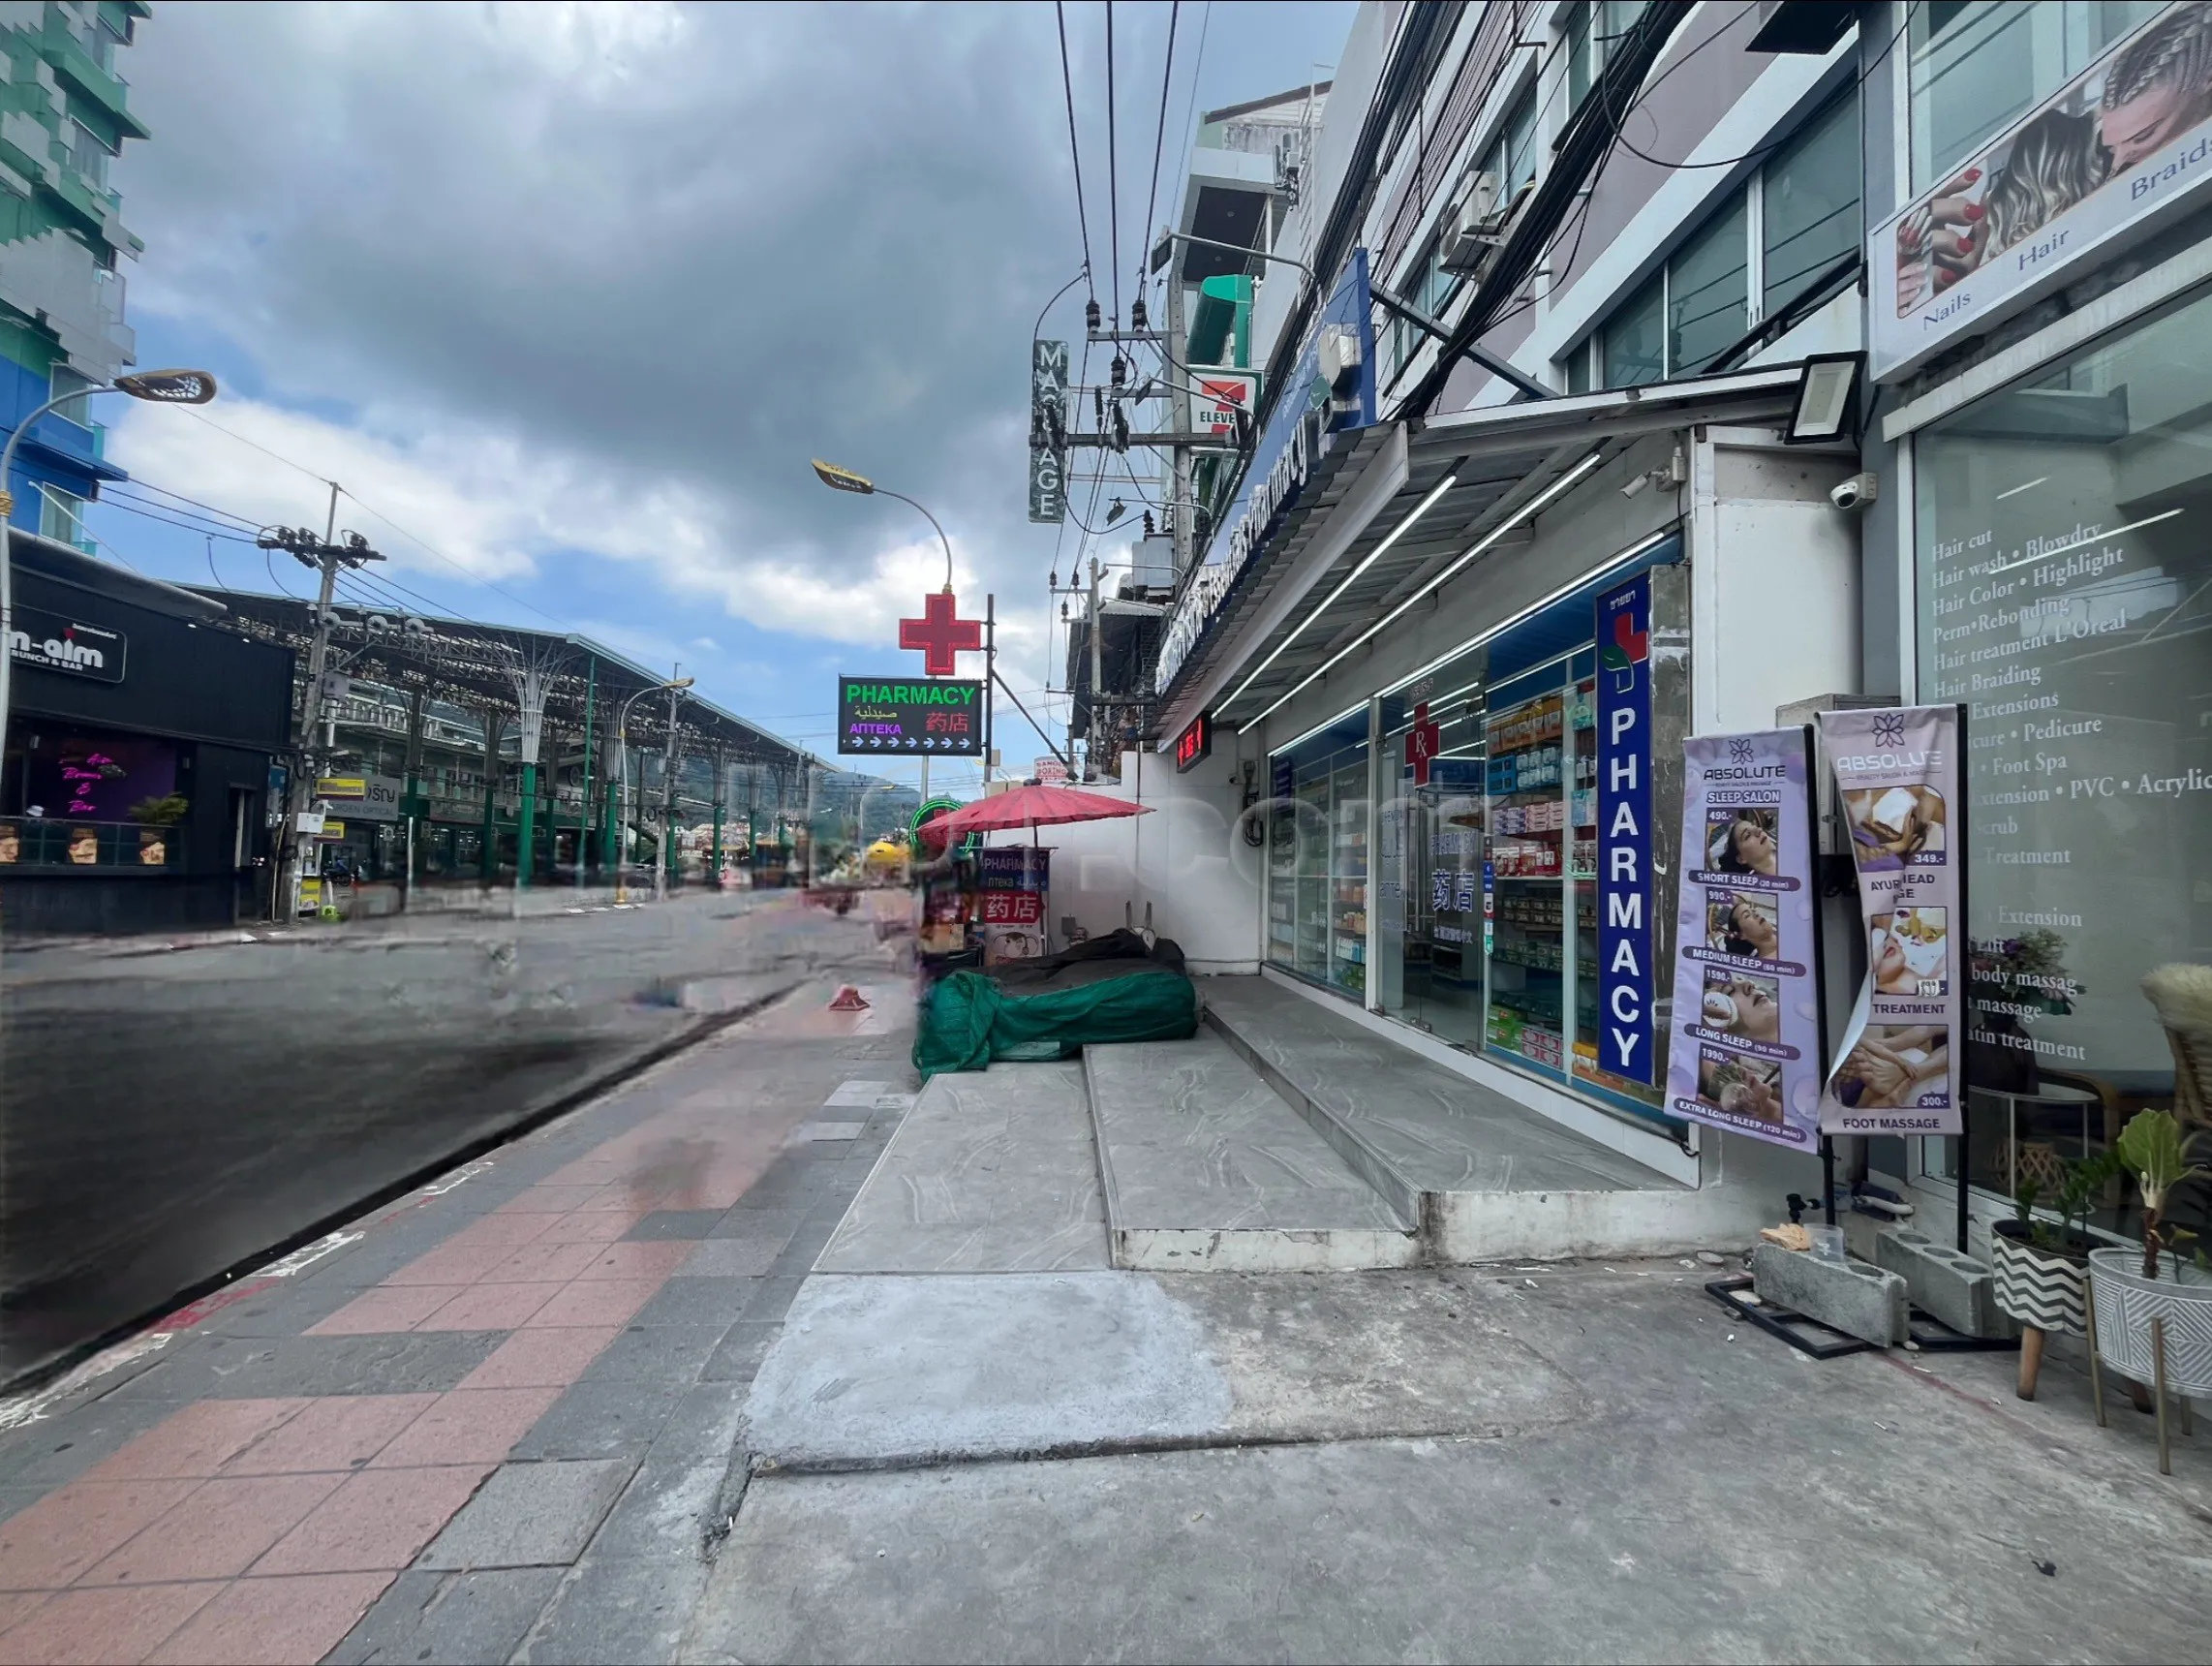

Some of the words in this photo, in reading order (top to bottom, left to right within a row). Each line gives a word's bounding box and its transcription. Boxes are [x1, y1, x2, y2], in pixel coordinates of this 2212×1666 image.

[2018, 229, 2070, 270] Hair
[1923, 293, 1972, 330] Nails
[1200, 412, 1236, 424] ELEVE
[1037, 345, 1061, 516] MAAGE
[1931, 538, 1963, 562] Hair
[1968, 530, 1993, 549] cut
[1931, 565, 1964, 589] Hair
[1968, 549, 2008, 574] wash
[2025, 523, 2103, 559] Blowdry
[1932, 593, 1964, 616] Hair
[1970, 580, 2014, 605] Color
[2034, 546, 2125, 587] Highlight
[11, 650, 49, 663] RUNCH
[61, 661, 83, 671] BAR
[1933, 649, 1967, 671] Hair
[1971, 632, 2049, 663] treatment
[1934, 680, 1967, 698] Hair
[1971, 665, 2043, 693] Braiding
[846, 685, 974, 705] PHARMACY
[1972, 691, 2059, 720] Extensions
[855, 706, 898, 720] صيدلية
[926, 712, 968, 732] 药店
[849, 724, 903, 734] АПТЕКА
[2023, 718, 2104, 742] Pedicure
[1704, 765, 1786, 780] ABSOLUTE
[1993, 757, 2030, 775] Foot
[2035, 752, 2068, 776] Spa
[1706, 790, 1741, 803] SLEEP
[1742, 789, 1781, 803] SALON
[2070, 776, 2115, 799] PVC
[1914, 853, 1944, 863] 349.-
[1983, 847, 2072, 865] Treatment
[1431, 869, 1475, 912] 药店
[1609, 707, 1643, 1066] PHARMACY
[1697, 873, 1730, 883] SHORT
[1732, 876, 1758, 885] SLEEP
[987, 894, 1037, 918] 药店
[1998, 907, 2083, 927] Extension
[1692, 948, 1730, 964] MEDIUM
[1732, 956, 1762, 969] SLEEP
[1971, 962, 2011, 989] body
[2015, 972, 2078, 998] massag
[1873, 1003, 1946, 1014] TREATMENT
[1977, 999, 2043, 1024] massage
[1696, 1027, 1721, 1041] LONG
[1722, 1034, 1752, 1048] SLEEP
[2001, 1033, 2086, 1061] treatment
[1703, 1048, 1729, 1062] 1990.-
[1921, 1096, 1948, 1106] 300.-
[1679, 1100, 1705, 1114] EXTRA
[1707, 1108, 1731, 1122] LONG
[1733, 1115, 1762, 1128] SLEEP
[1763, 1124, 1780, 1134] (120
[1782, 1128, 1800, 1139] min)
[1843, 1119, 1876, 1128] FOOT
[1880, 1118, 1941, 1129] MASSAGE
